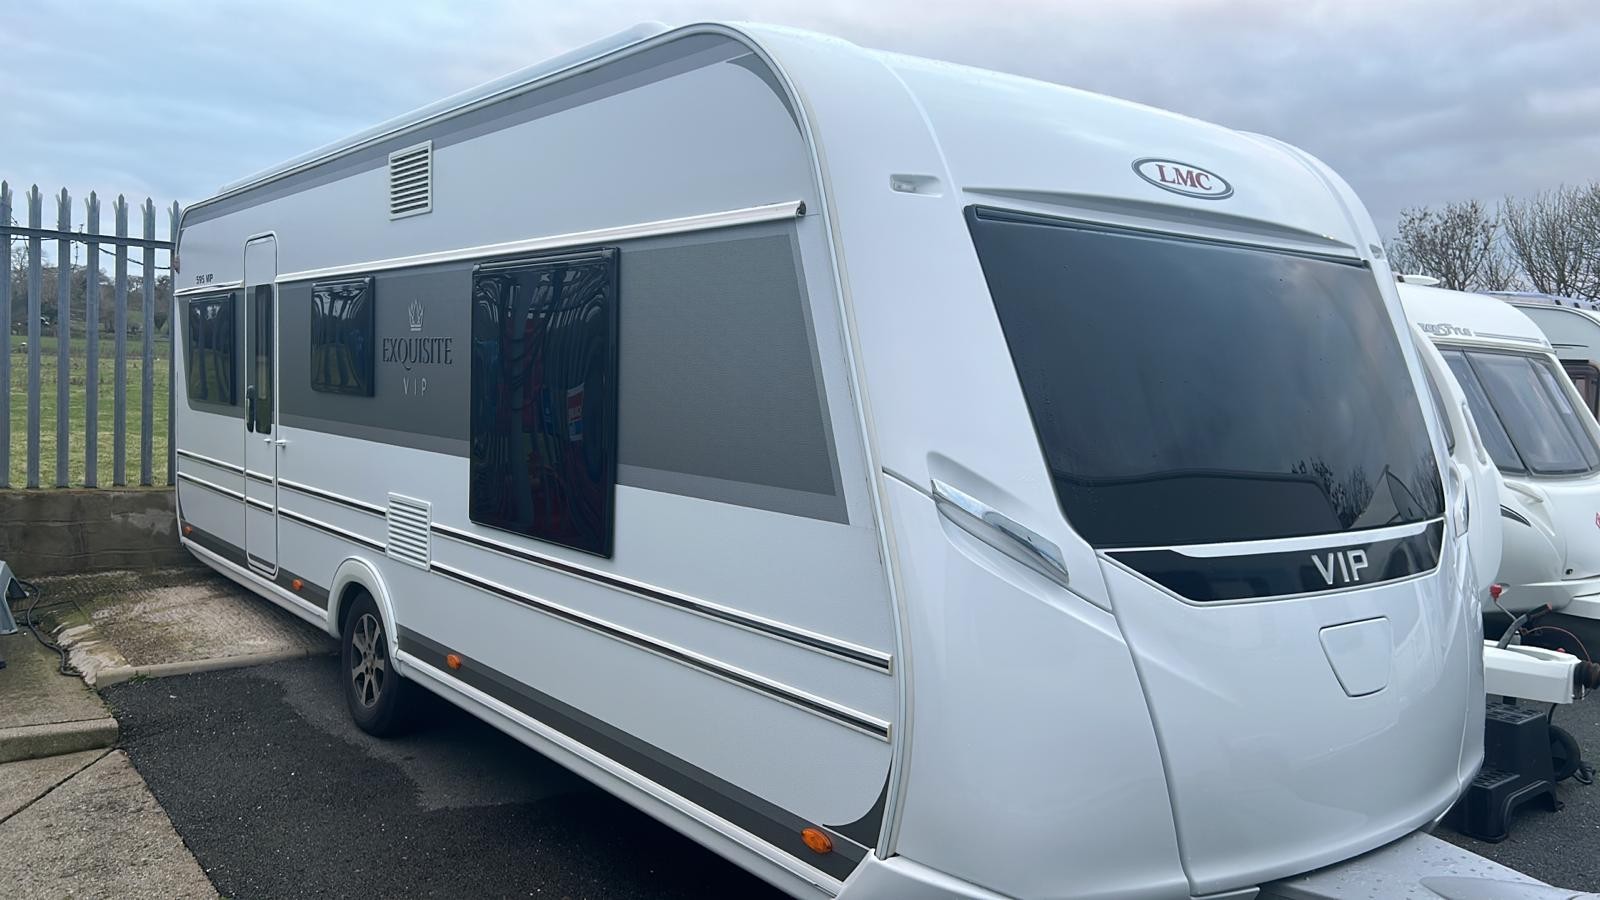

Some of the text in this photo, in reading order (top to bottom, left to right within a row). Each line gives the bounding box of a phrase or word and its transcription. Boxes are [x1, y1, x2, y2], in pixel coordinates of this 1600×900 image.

[1154, 163, 1213, 191] LMC
[382, 337, 453, 371] EXQUISITE
[1310, 548, 1369, 585] VIP
